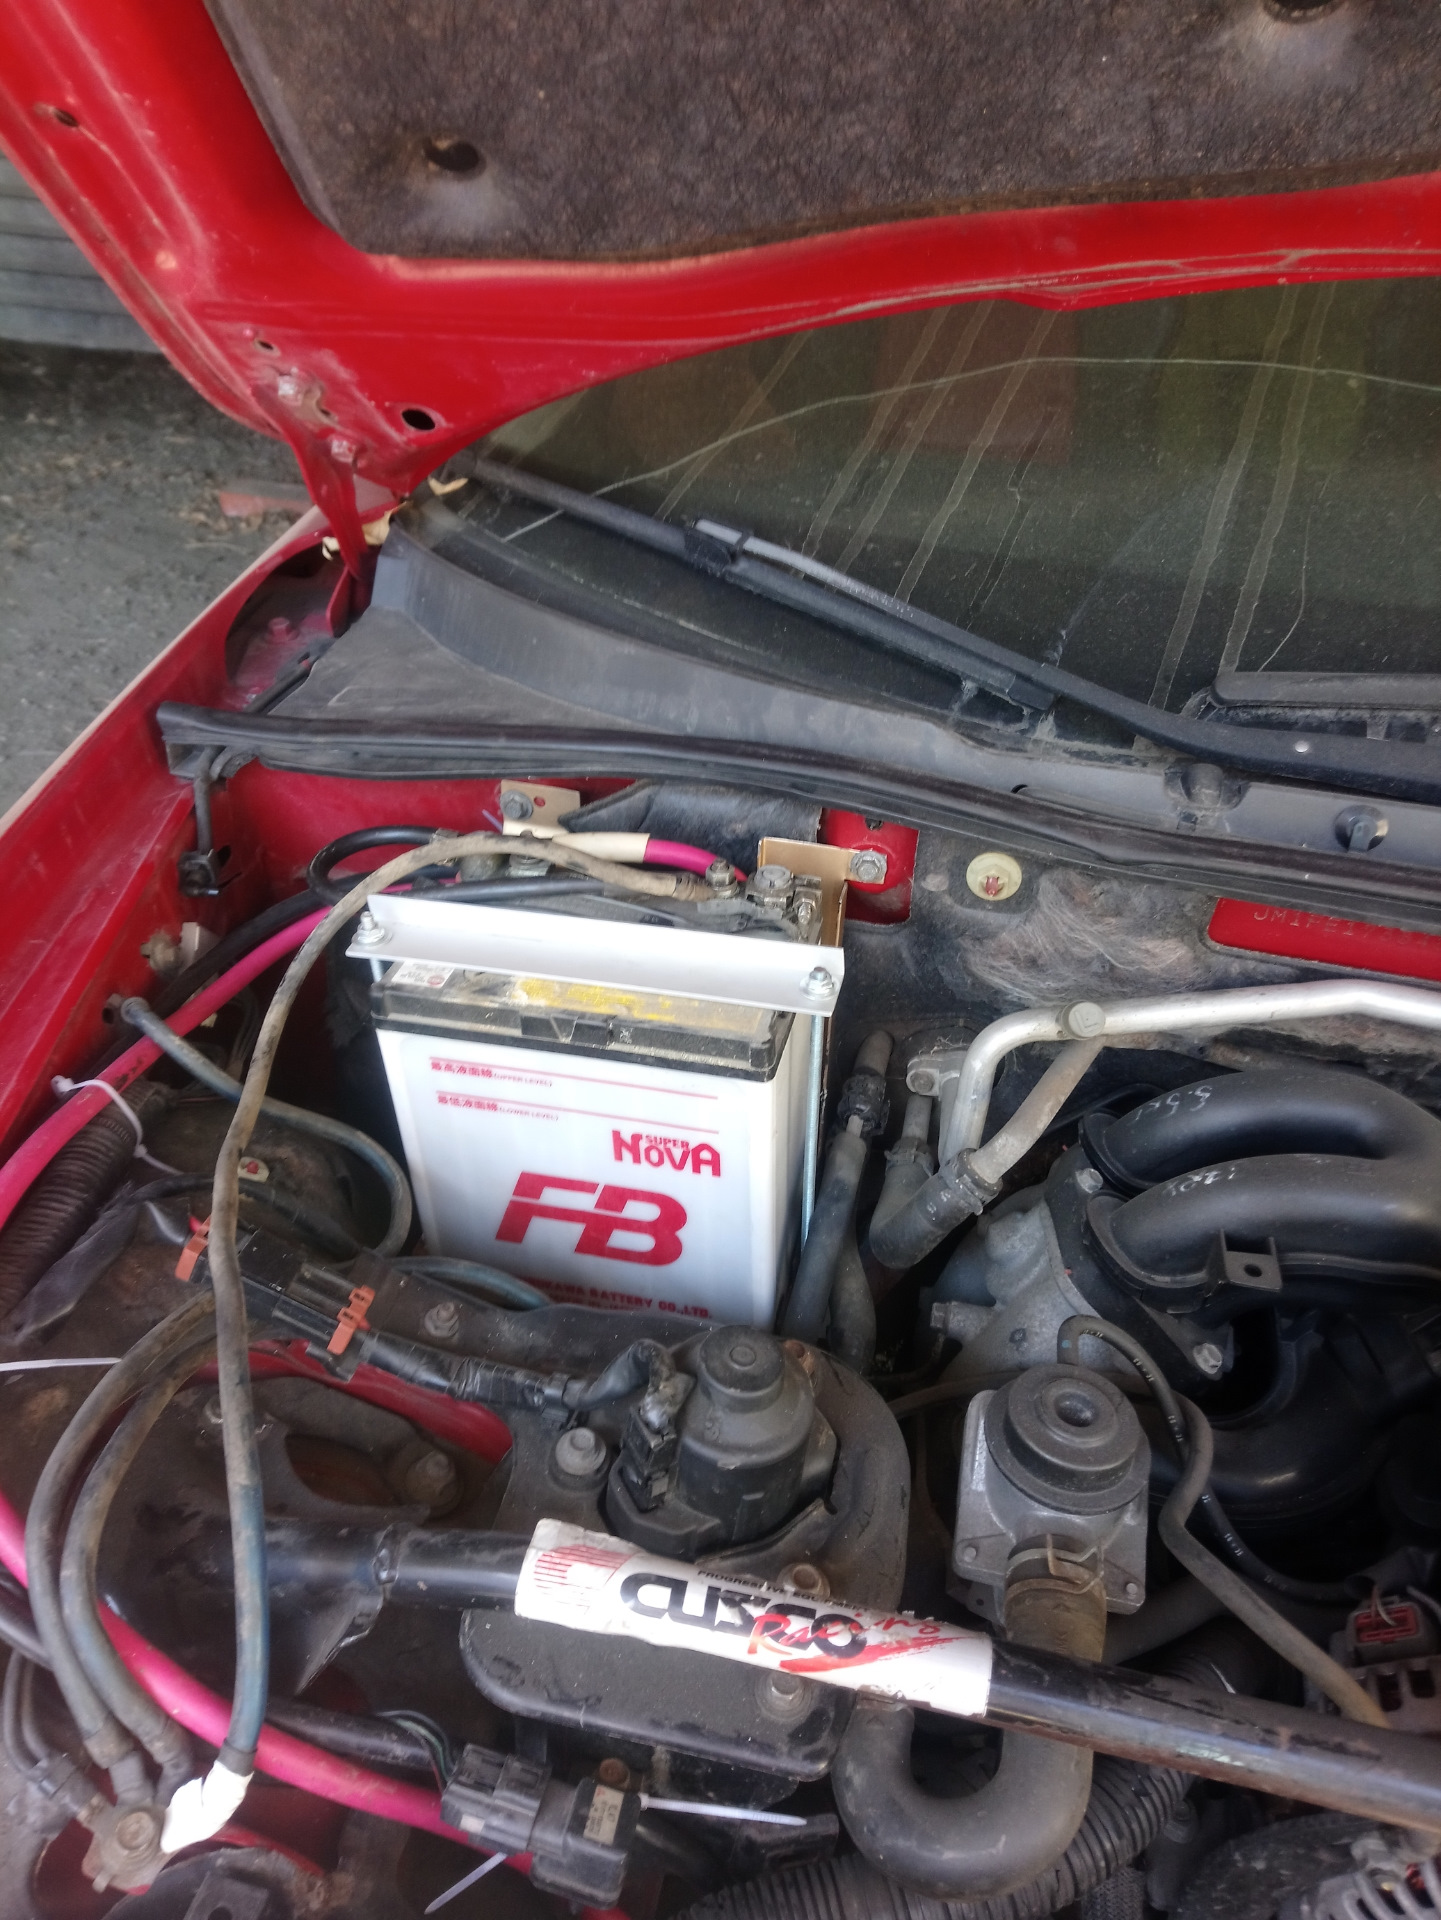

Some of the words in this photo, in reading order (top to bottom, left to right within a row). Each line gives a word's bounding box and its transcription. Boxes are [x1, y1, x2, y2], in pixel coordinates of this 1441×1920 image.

[611, 1129, 721, 1178] NOVA
[645, 1134, 690, 1151] SUPER
[495, 1170, 688, 1267] FB
[588, 1286, 653, 1308] BATTERY
